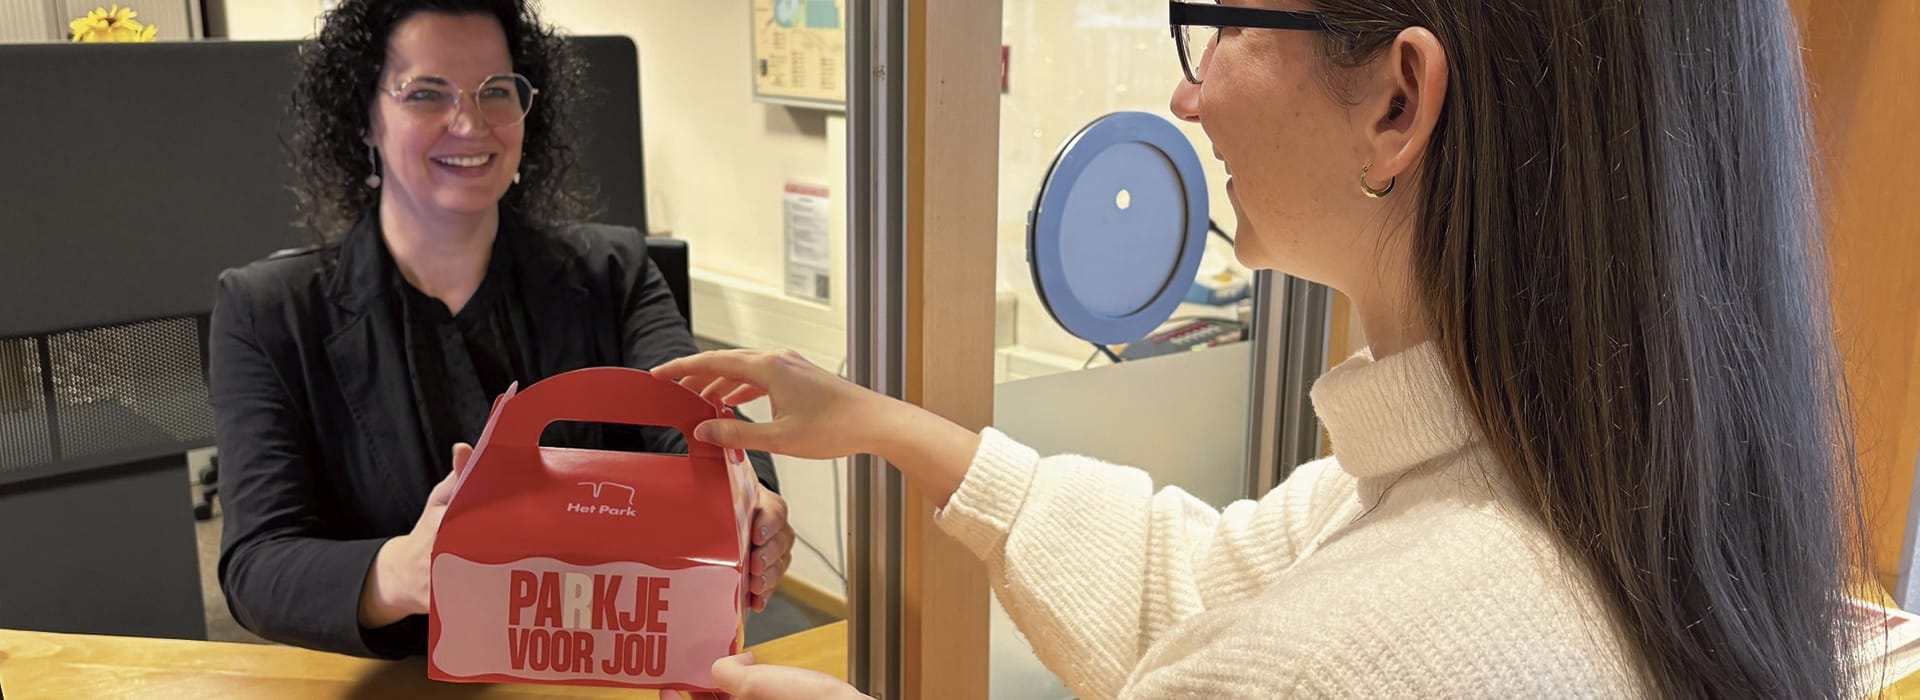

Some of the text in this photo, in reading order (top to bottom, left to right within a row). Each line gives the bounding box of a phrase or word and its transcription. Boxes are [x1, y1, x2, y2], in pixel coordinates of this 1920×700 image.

[567, 502, 636, 517] Het Park
[508, 569, 670, 633] PARKJE
[508, 627, 667, 677] VOOR JOU
